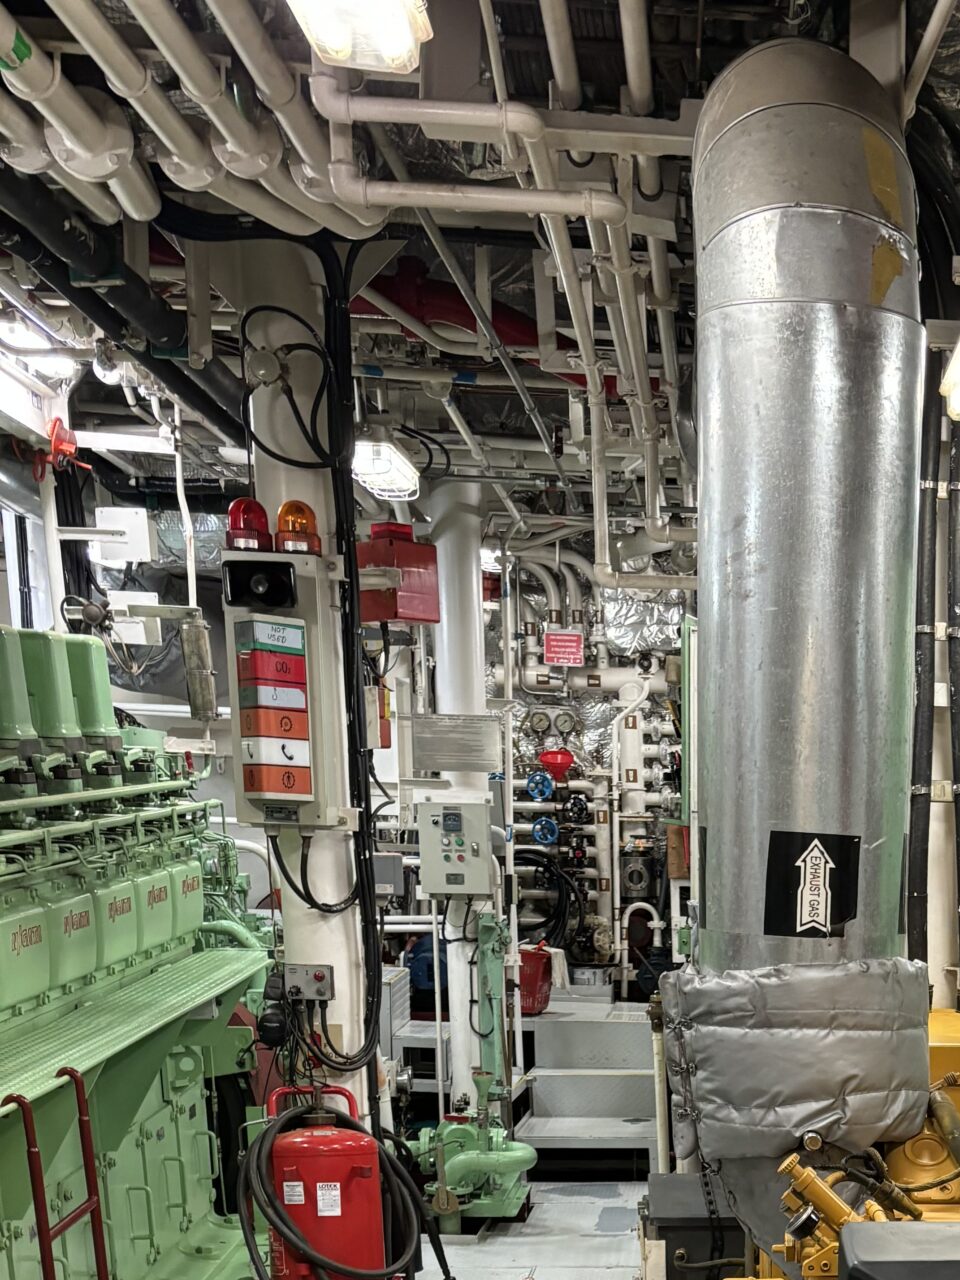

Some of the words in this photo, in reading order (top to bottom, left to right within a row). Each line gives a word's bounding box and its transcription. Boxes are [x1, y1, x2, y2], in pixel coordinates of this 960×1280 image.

[271, 625, 287, 634] NOT
[267, 633, 288, 644] USED
[809, 855, 822, 898] EXHAUST
[808, 899, 821, 918] GAS
